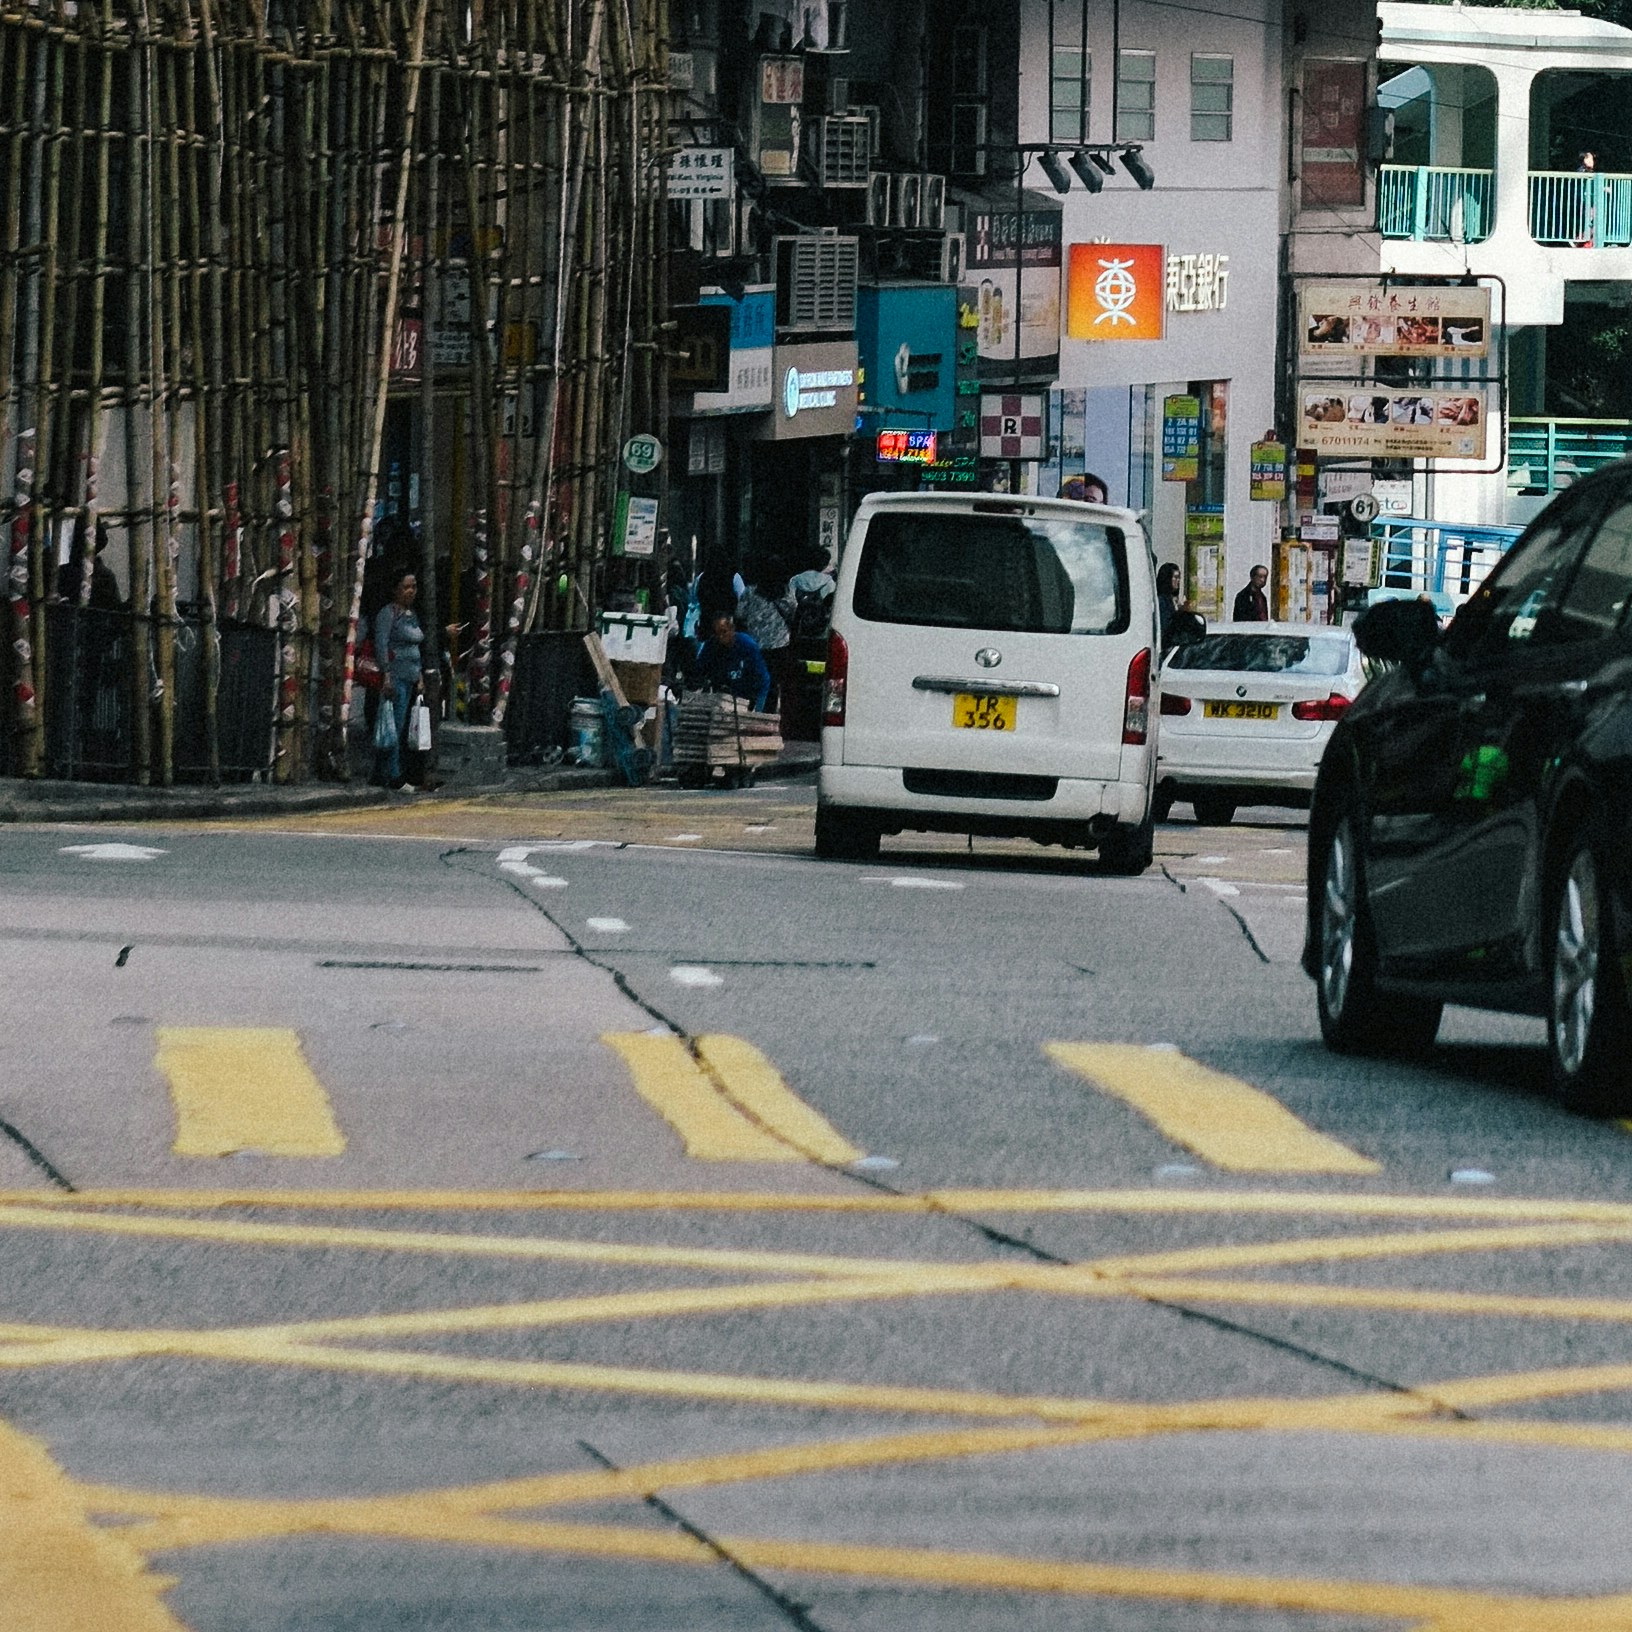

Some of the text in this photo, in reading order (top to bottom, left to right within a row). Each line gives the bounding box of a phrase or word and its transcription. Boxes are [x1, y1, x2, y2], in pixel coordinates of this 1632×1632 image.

[631, 442, 653, 458] 69
[1355, 499, 1374, 516] 61
[972, 695, 999, 713] TR
[1236, 703, 1273, 718] 3210
[963, 711, 1006, 731] 356
